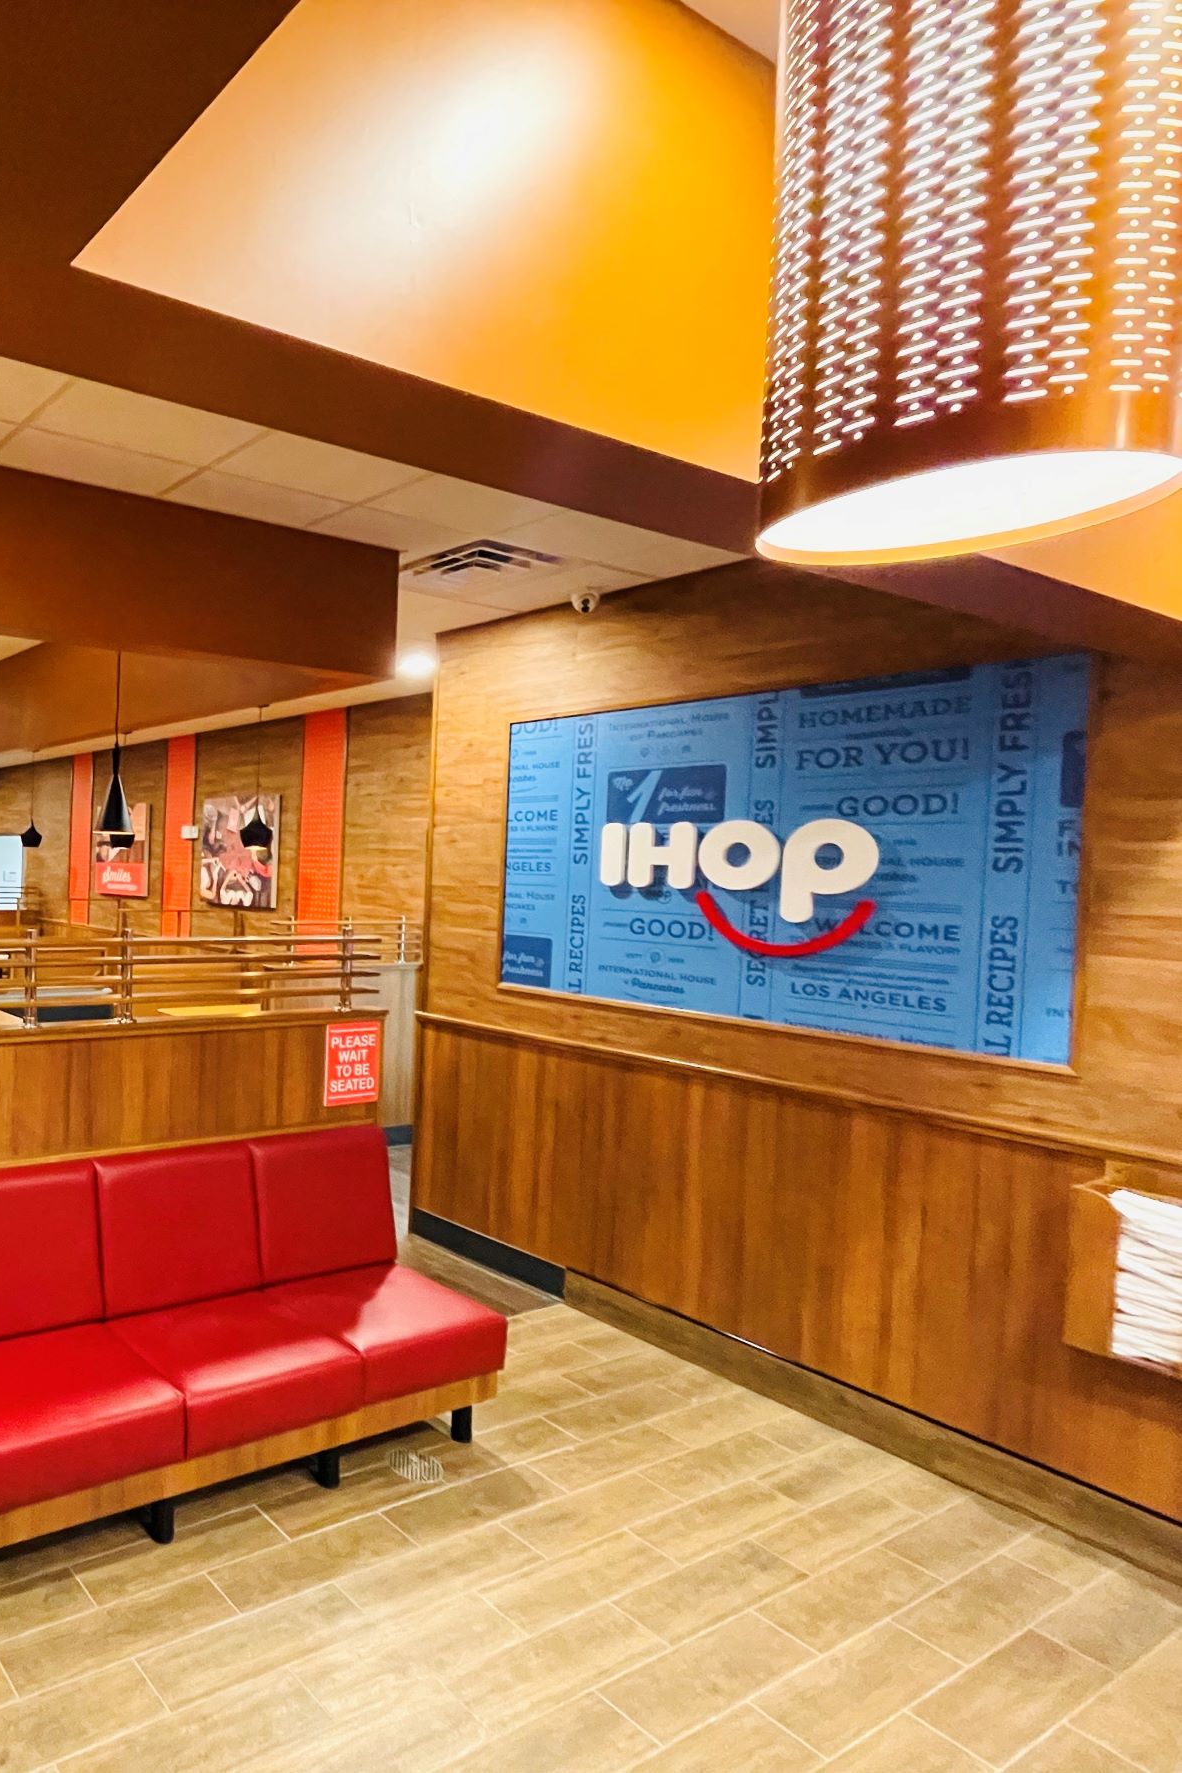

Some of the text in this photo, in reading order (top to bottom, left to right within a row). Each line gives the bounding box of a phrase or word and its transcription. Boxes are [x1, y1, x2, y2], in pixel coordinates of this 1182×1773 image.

[798, 696, 973, 729] HOMEMADE
[795, 738, 970, 771] FOR YOU!
[836, 791, 959, 817] GOOD!
[573, 787, 592, 864] SIMPLY
[992, 763, 1028, 874] SIMPLY
[569, 894, 587, 974] RECIPES
[629, 917, 714, 941] GOOD!
[814, 917, 961, 942] WLCOME
[985, 915, 1019, 1028] RECIPES
[791, 982, 831, 998] LOS
[837, 987, 947, 1013] ANGELES
[331, 1034, 377, 1049] PLEASE
[336, 1063, 370, 1077] TO BE
[338, 1050, 369, 1063] WAIT
[329, 1077, 375, 1093] SEATED
